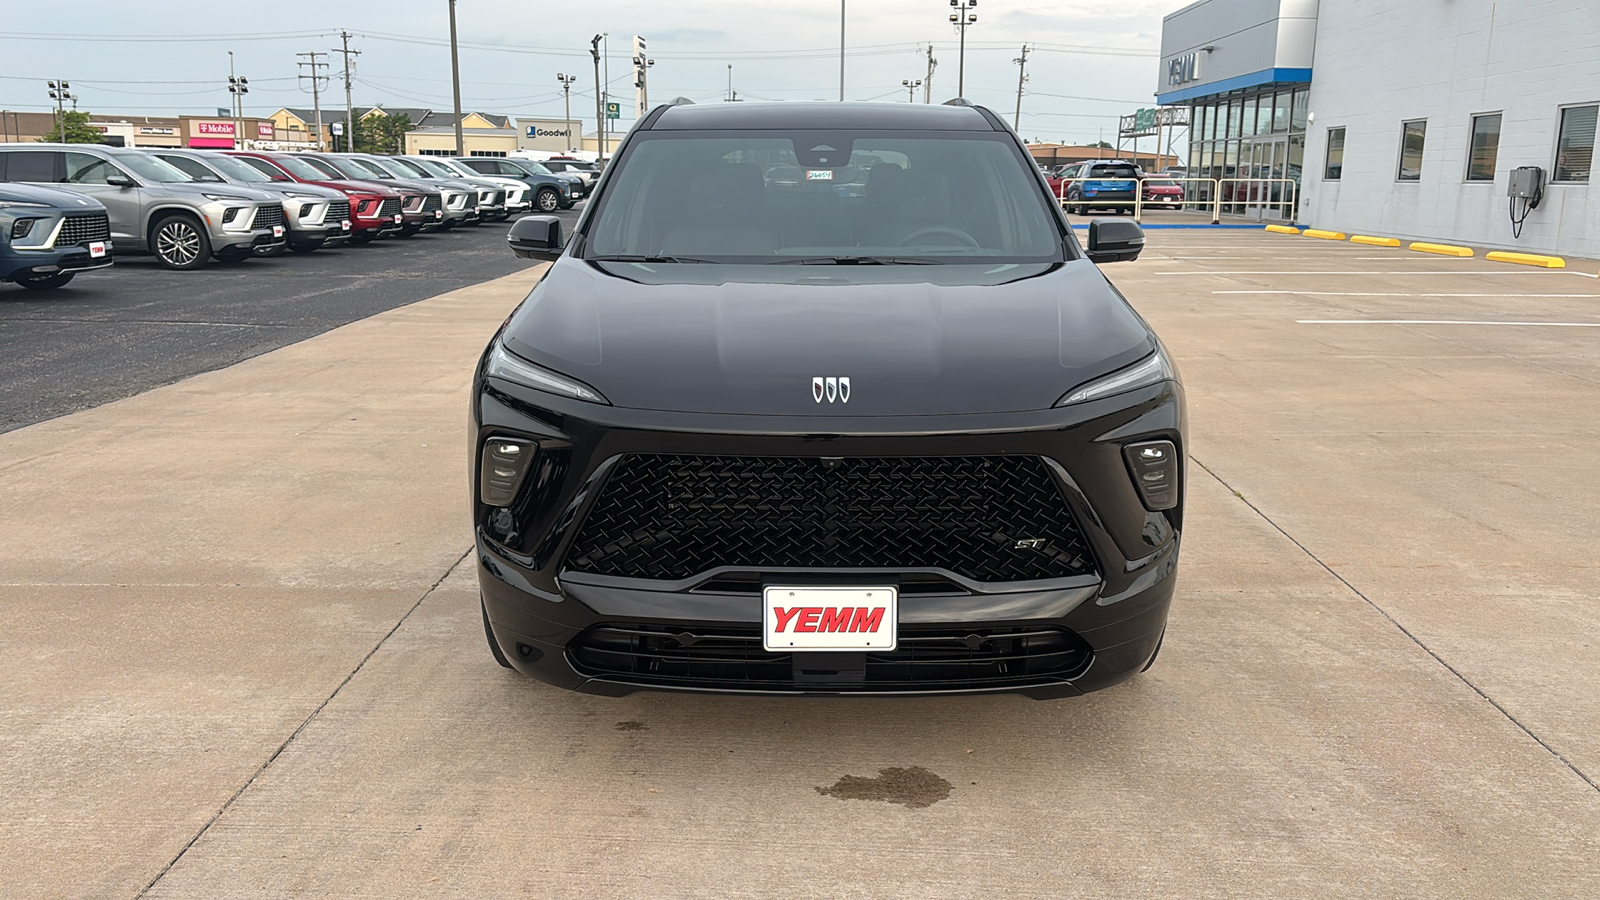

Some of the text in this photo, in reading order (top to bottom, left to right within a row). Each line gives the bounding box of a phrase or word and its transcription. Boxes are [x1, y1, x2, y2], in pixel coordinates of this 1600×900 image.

[537, 129, 571, 137] Goodwil
[1015, 538, 1046, 549] ST
[773, 607, 886, 633] YEMM
